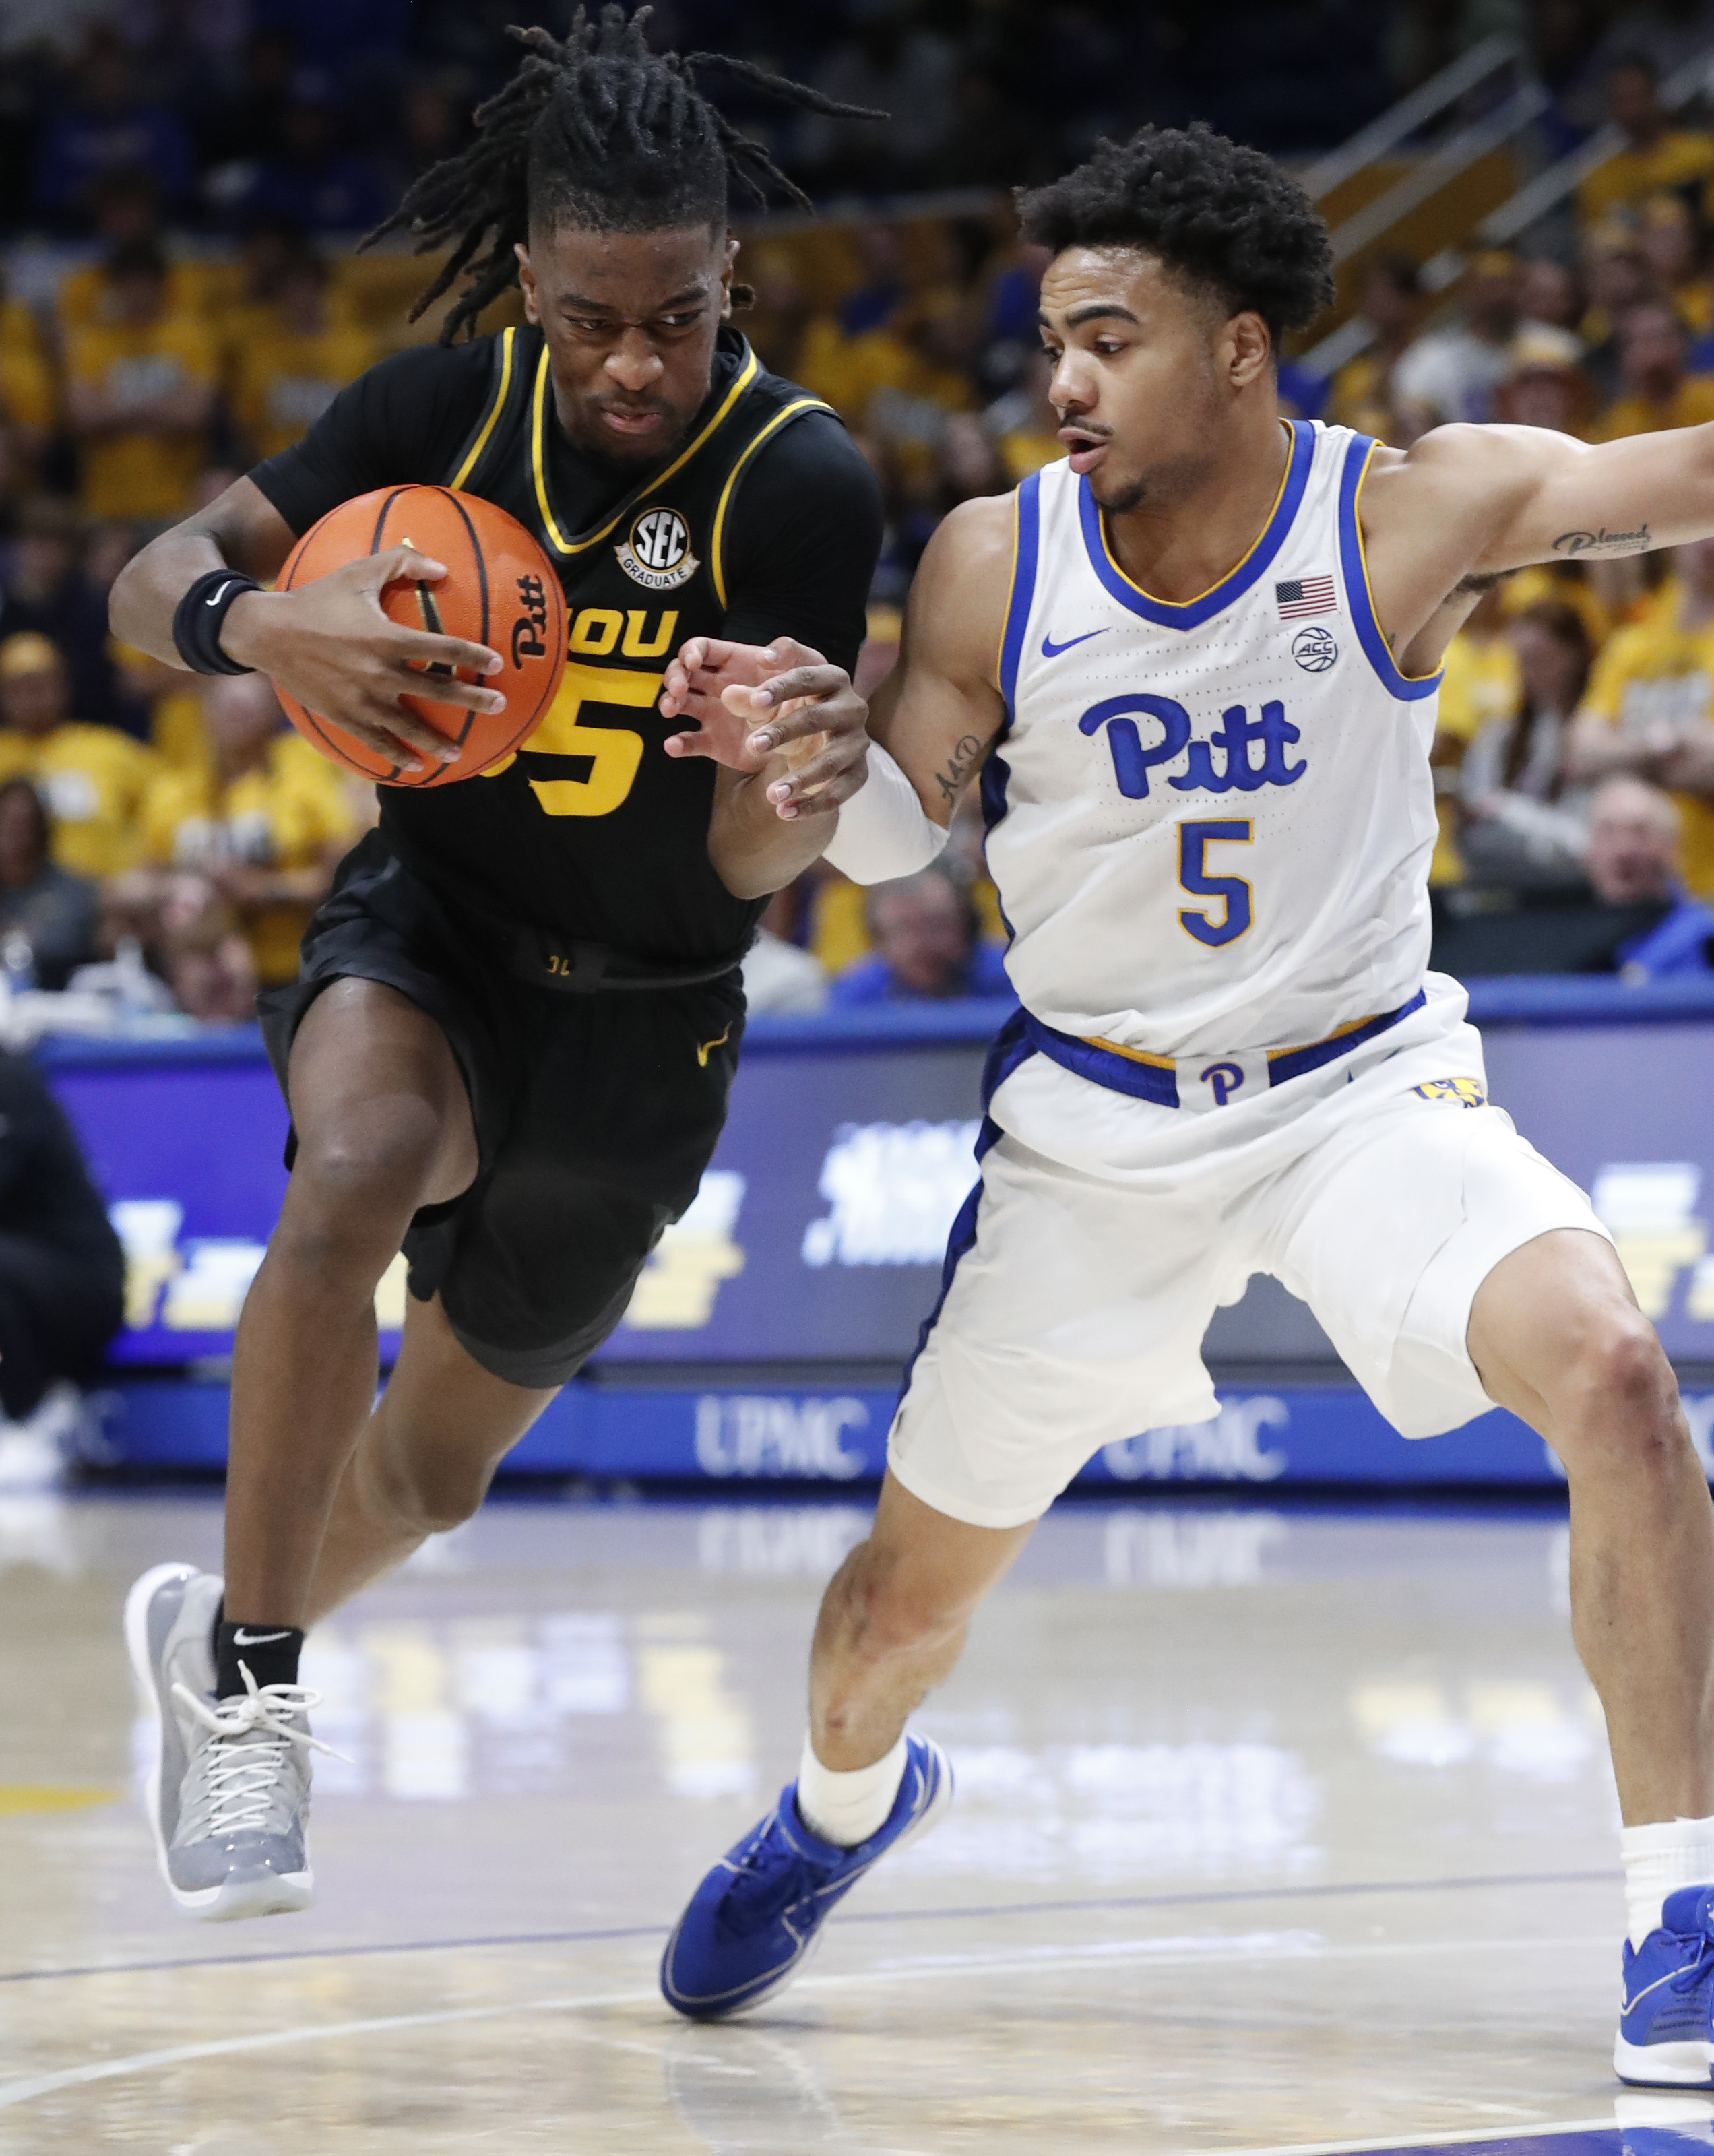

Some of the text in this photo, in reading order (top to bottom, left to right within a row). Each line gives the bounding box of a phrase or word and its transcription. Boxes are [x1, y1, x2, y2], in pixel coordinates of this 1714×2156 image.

[623, 558, 687, 587] GRADUATE
[635, 511, 686, 567] SEC
[511, 574, 546, 670] Pitt
[566, 608, 679, 658] OU
[1297, 641, 1333, 654] ACC
[480, 661, 665, 817] 5
[1079, 693, 1308, 800] Pitt
[1177, 817, 1255, 947] 5
[1199, 1062, 1245, 1106] P
[695, 1394, 870, 1480] UPMC
